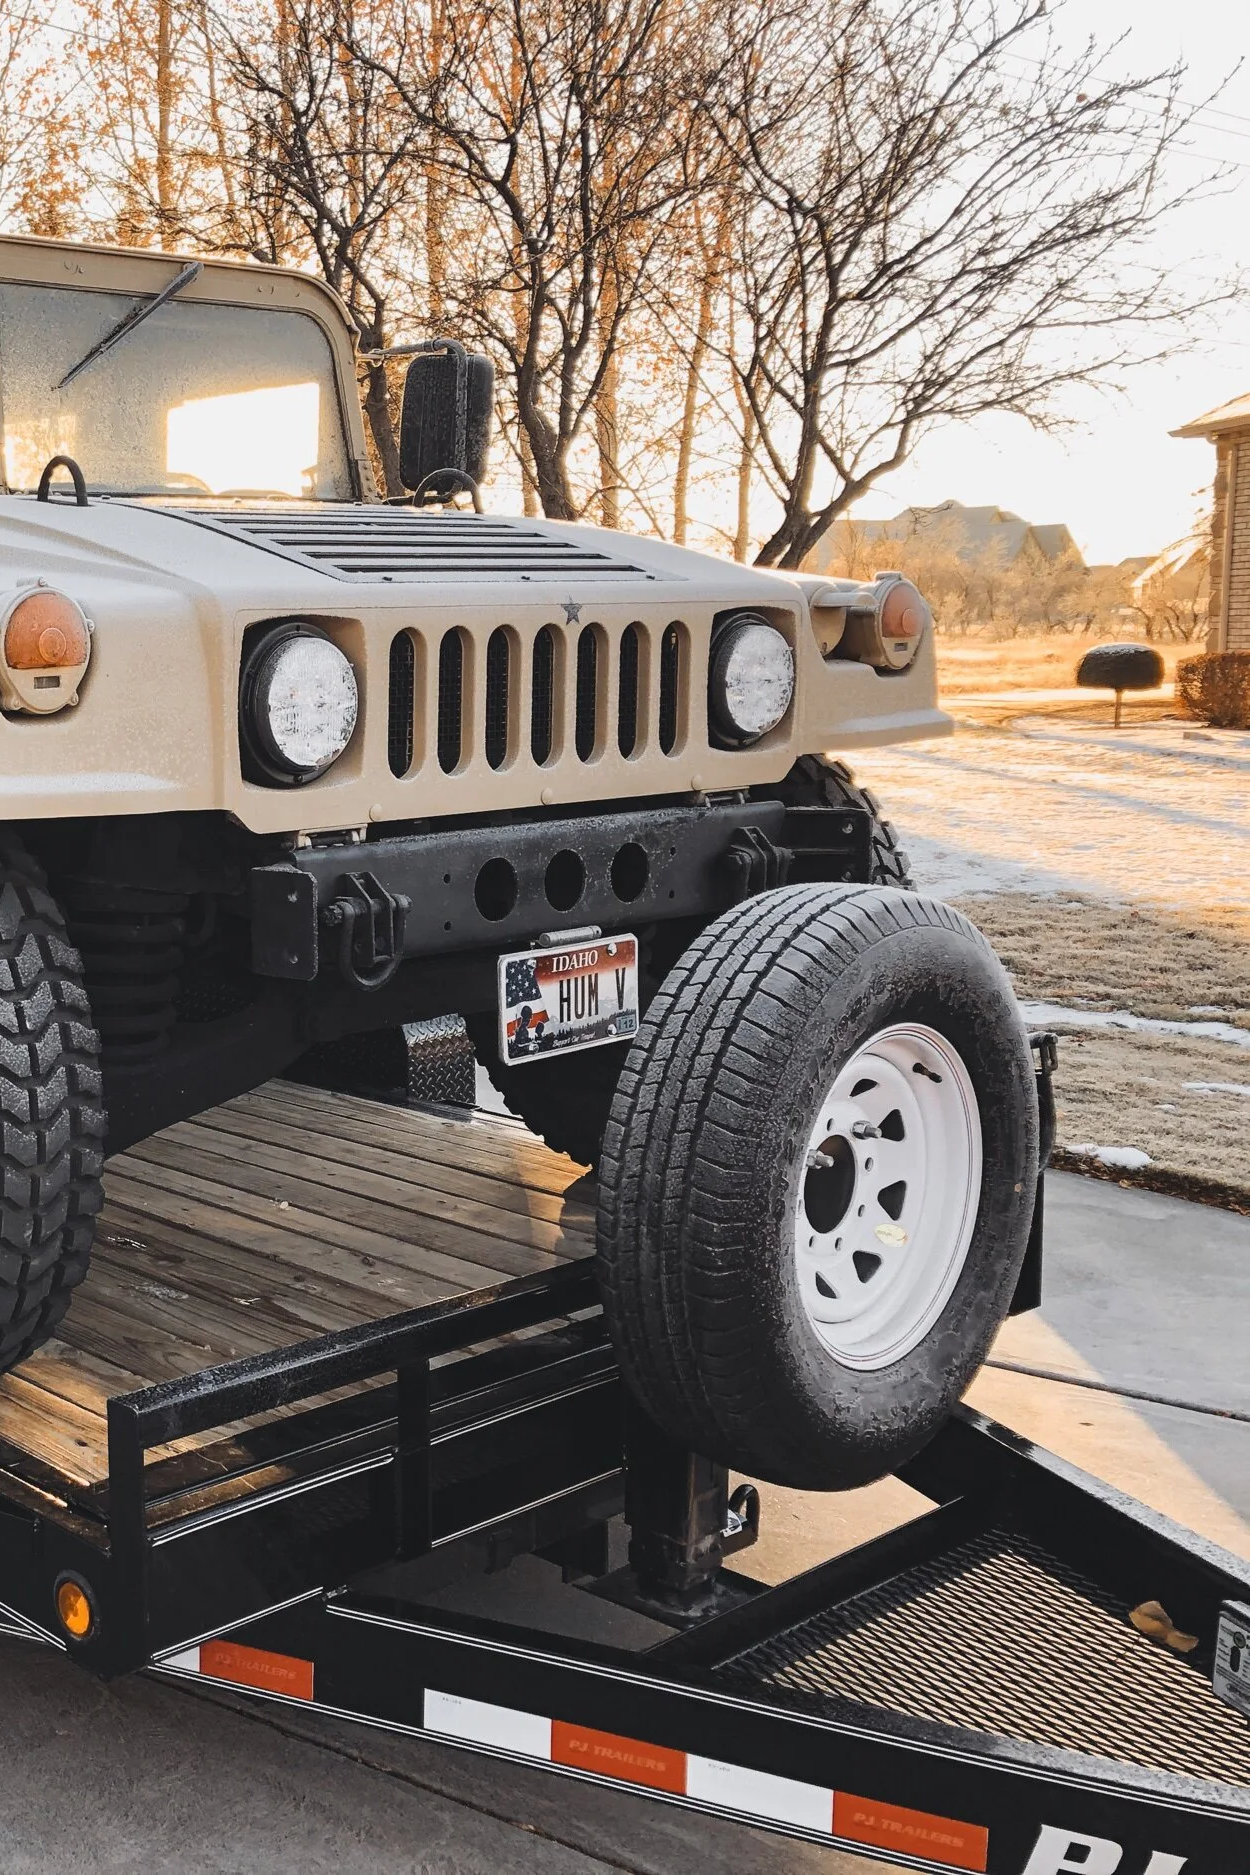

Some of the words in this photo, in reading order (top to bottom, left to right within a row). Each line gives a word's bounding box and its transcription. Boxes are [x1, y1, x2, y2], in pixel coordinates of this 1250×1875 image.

[551, 950, 599, 973] IDAHO
[559, 972, 599, 1023] HUM
[615, 967, 627, 1010] V
[234, 1657, 297, 1680] TRAILERS
[568, 1739, 589, 1754] PJ
[592, 1745, 666, 1773] TRAILERS
[853, 1812, 874, 1826] PJ
[881, 1818, 966, 1848] TRAILERS
